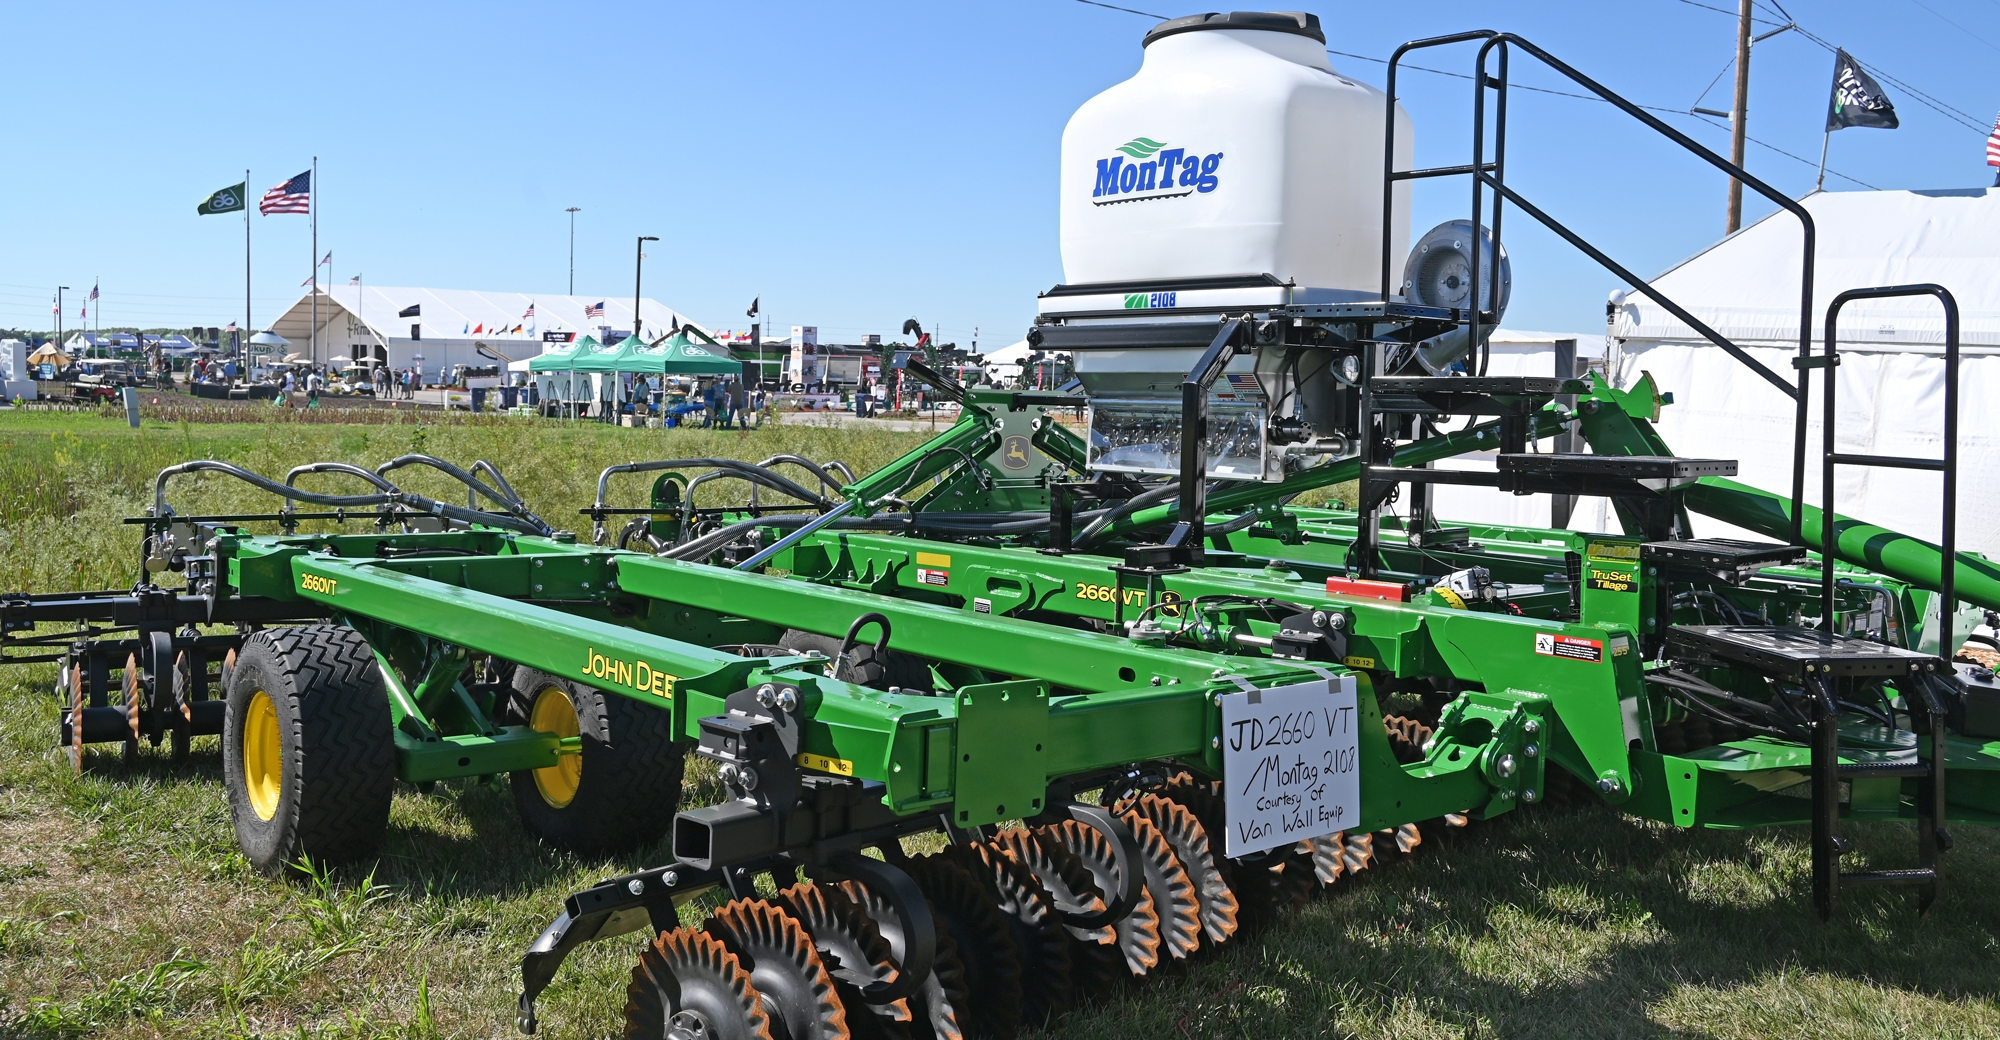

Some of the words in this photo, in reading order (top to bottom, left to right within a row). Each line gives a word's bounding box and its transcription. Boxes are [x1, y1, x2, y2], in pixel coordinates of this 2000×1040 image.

[1092, 147, 1224, 198] MonTag
[1150, 291, 1177, 308] 2108
[249, 345, 272, 354] ukup
[301, 572, 337, 597] 2660VT
[1590, 569, 1632, 582] TruSet
[1595, 579, 1628, 591] Tillage
[1569, 638, 1592, 646] DANGER
[582, 646, 632, 688] JOHN
[636, 660, 680, 700] DEE
[1324, 706, 1354, 737] VT
[803, 755, 809, 765] 8
[819, 759, 829, 769] 10
[838, 761, 847, 772] 12
[1323, 745, 1355, 775] 2108
[1310, 783, 1327, 801] of
[1238, 819, 1272, 844] Van
[1282, 808, 1313, 834] Wall
[1318, 805, 1344, 828] Equip
